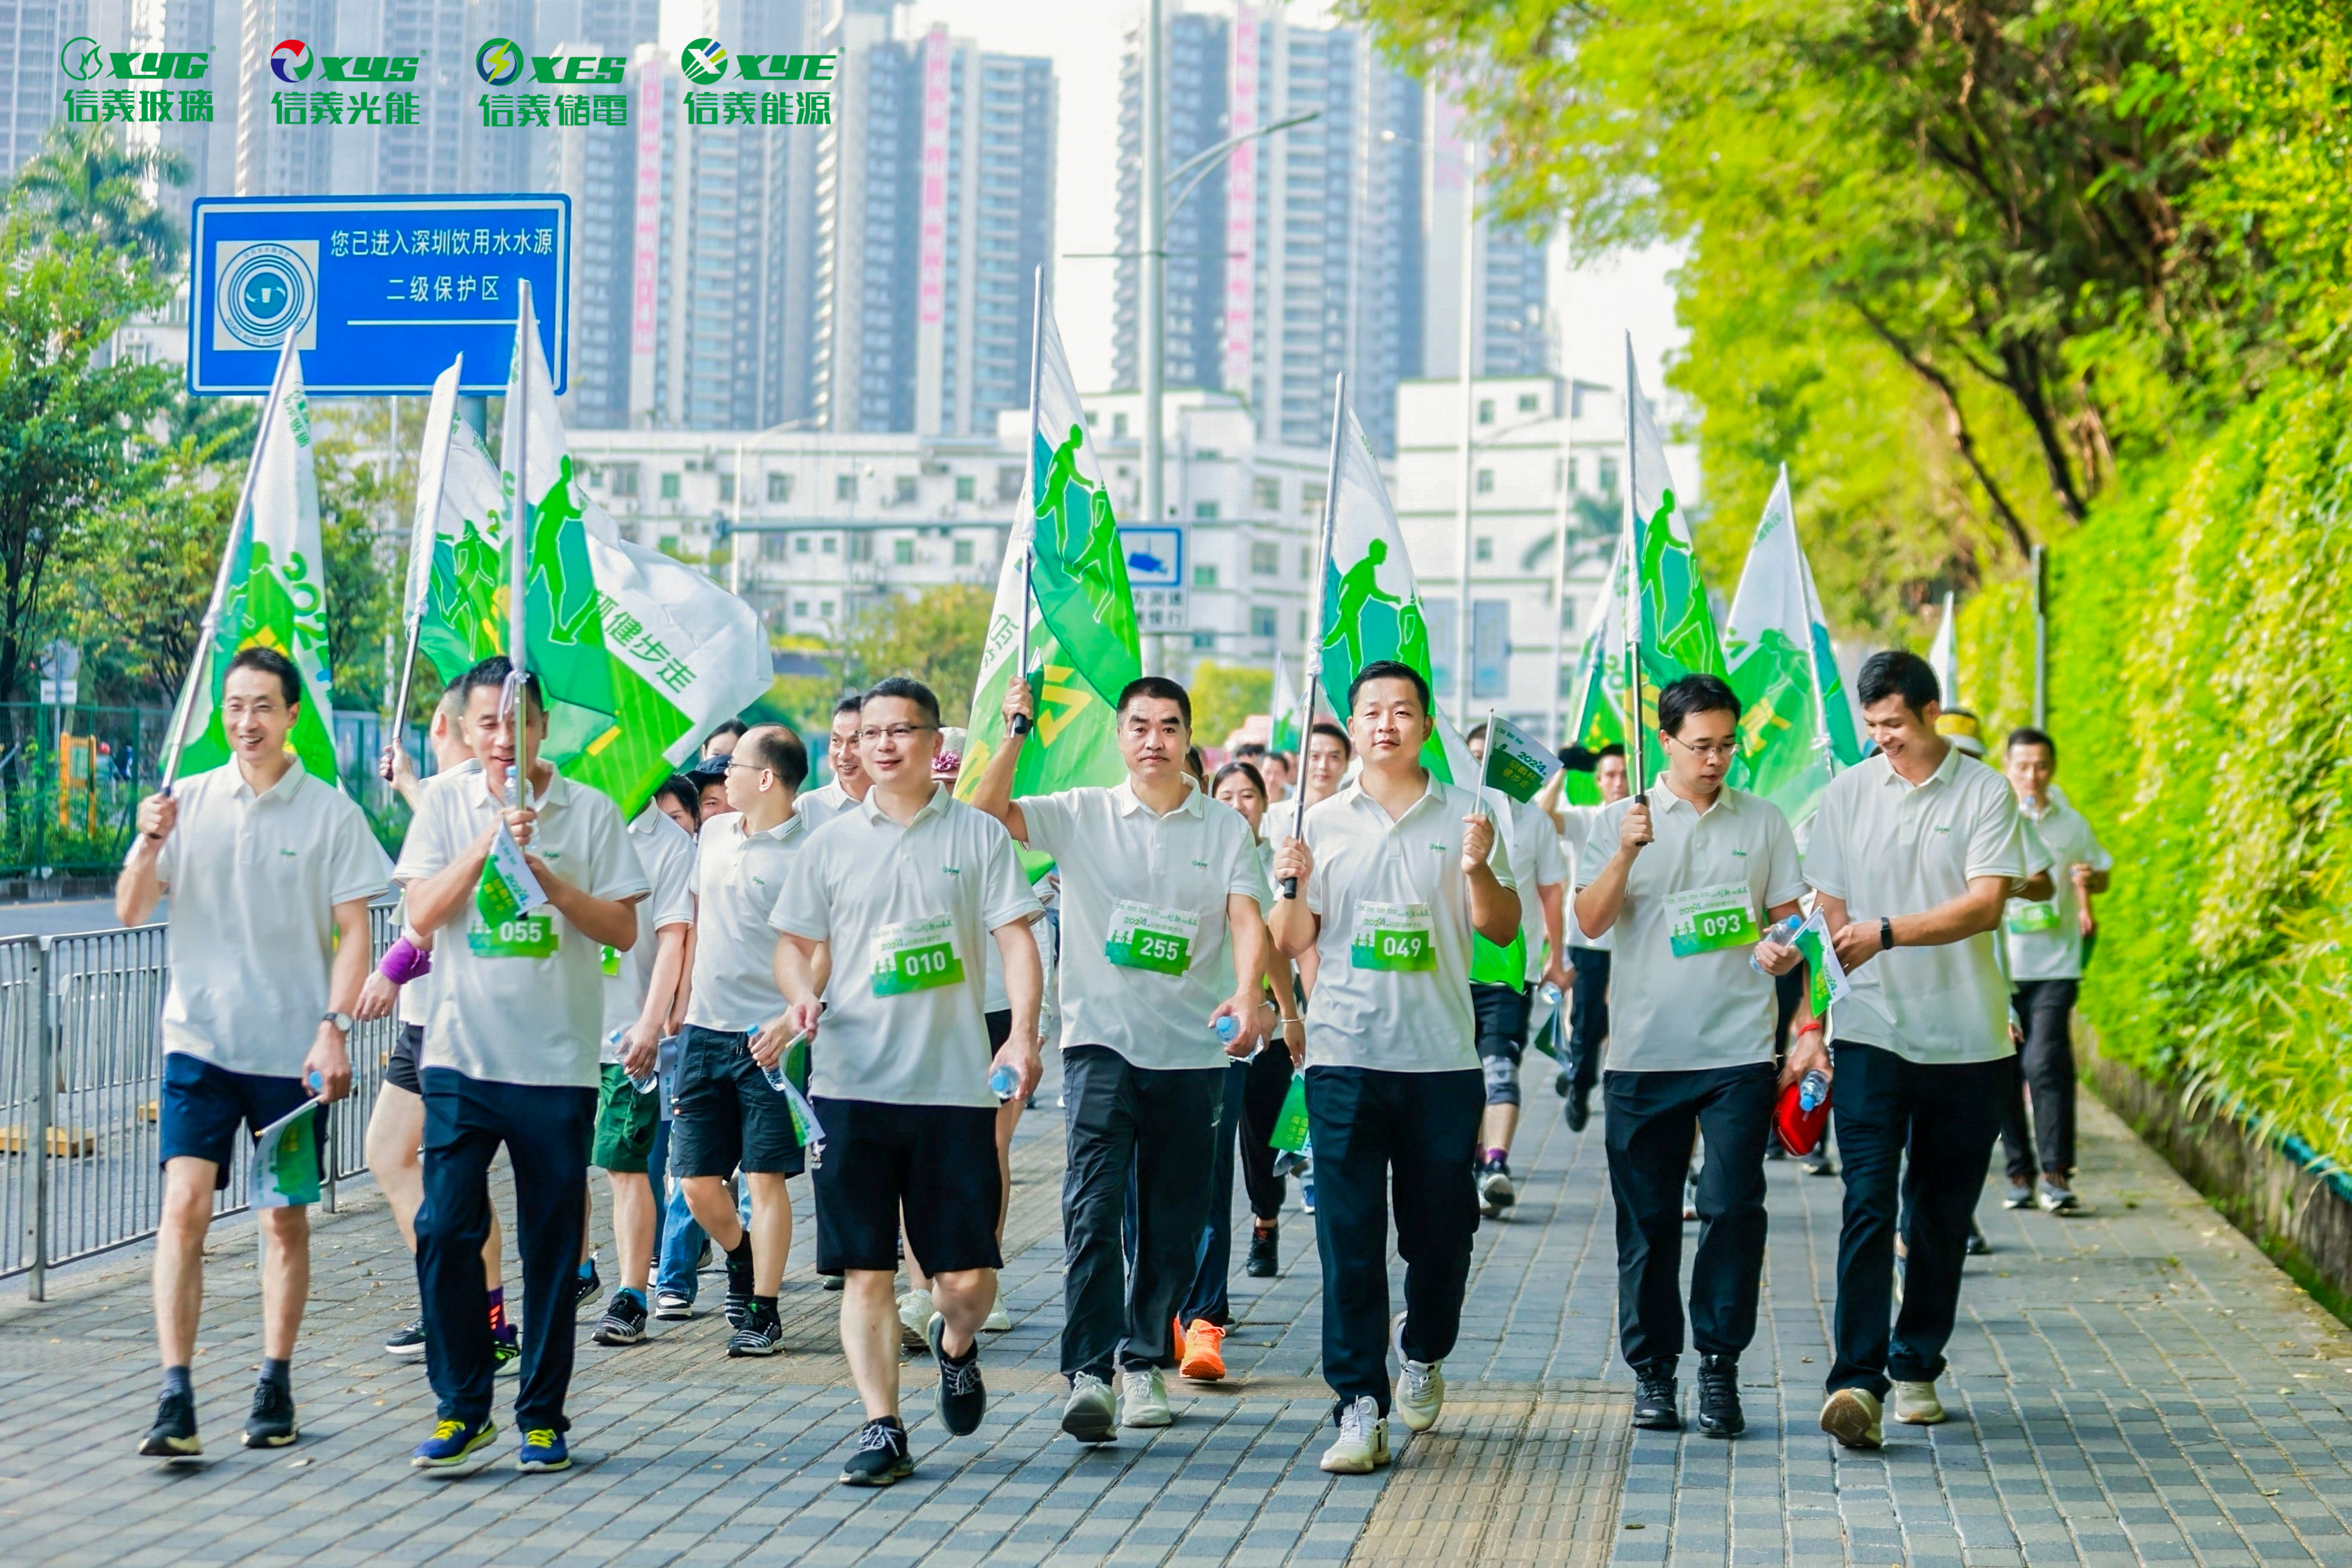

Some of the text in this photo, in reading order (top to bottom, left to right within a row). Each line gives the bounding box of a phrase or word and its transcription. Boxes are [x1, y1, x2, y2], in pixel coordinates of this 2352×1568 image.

[330, 228, 553, 257] 您已进入深圳饮用水水源
[386, 275, 500, 302] 二级保护区
[243, 333, 261, 344] WATER
[500, 921, 543, 942] 055
[1703, 914, 1741, 937] 093
[1140, 937, 1180, 961] 255
[1384, 936, 1422, 957] 049
[905, 950, 946, 977] 010
